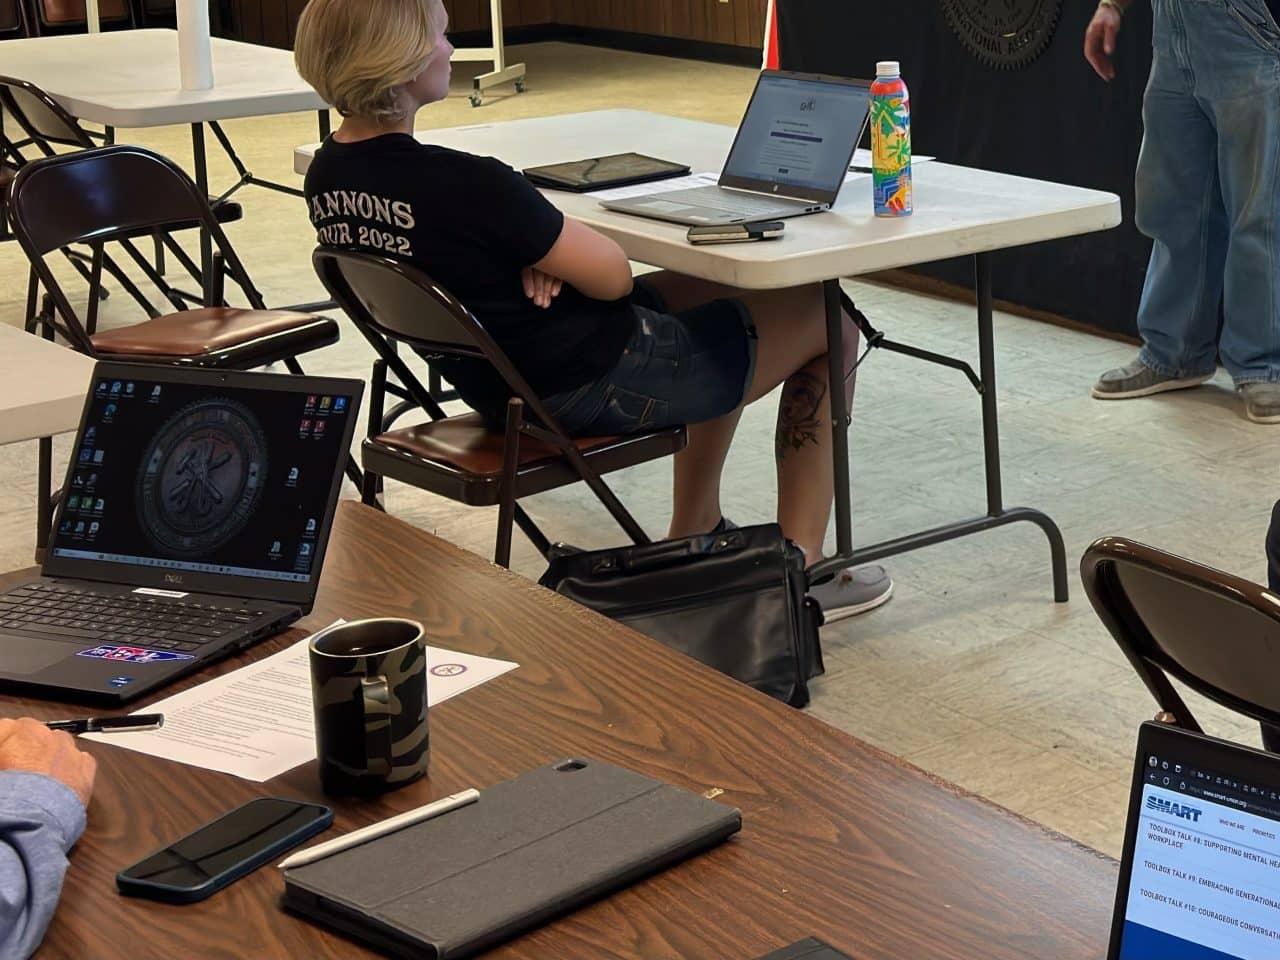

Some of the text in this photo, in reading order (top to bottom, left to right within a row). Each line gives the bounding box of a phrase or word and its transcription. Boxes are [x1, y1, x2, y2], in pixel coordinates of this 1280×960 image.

[311, 190, 416, 230] ANNONS
[318, 222, 413, 257] OUR 2022
[163, 573, 185, 585] DELL
[1146, 795, 1203, 823] SMART
[1147, 832, 1184, 849] WORKPLACE
[1149, 822, 1177, 837] TOOLBOX
[1177, 831, 1192, 841] TALK
[1203, 838, 1242, 857] SUPPORTING
[1242, 851, 1269, 865] MENTAL
[1144, 860, 1171, 876] TOOLBOX
[1172, 869, 1187, 880] TALK
[1198, 877, 1234, 895] EMBRACING
[1235, 888, 1280, 911] GENERATIONAL
[1140, 888, 1167, 904] TOOLBOX
[1167, 896, 1183, 908] TALK
[1198, 907, 1239, 927] COURAGEOUS
